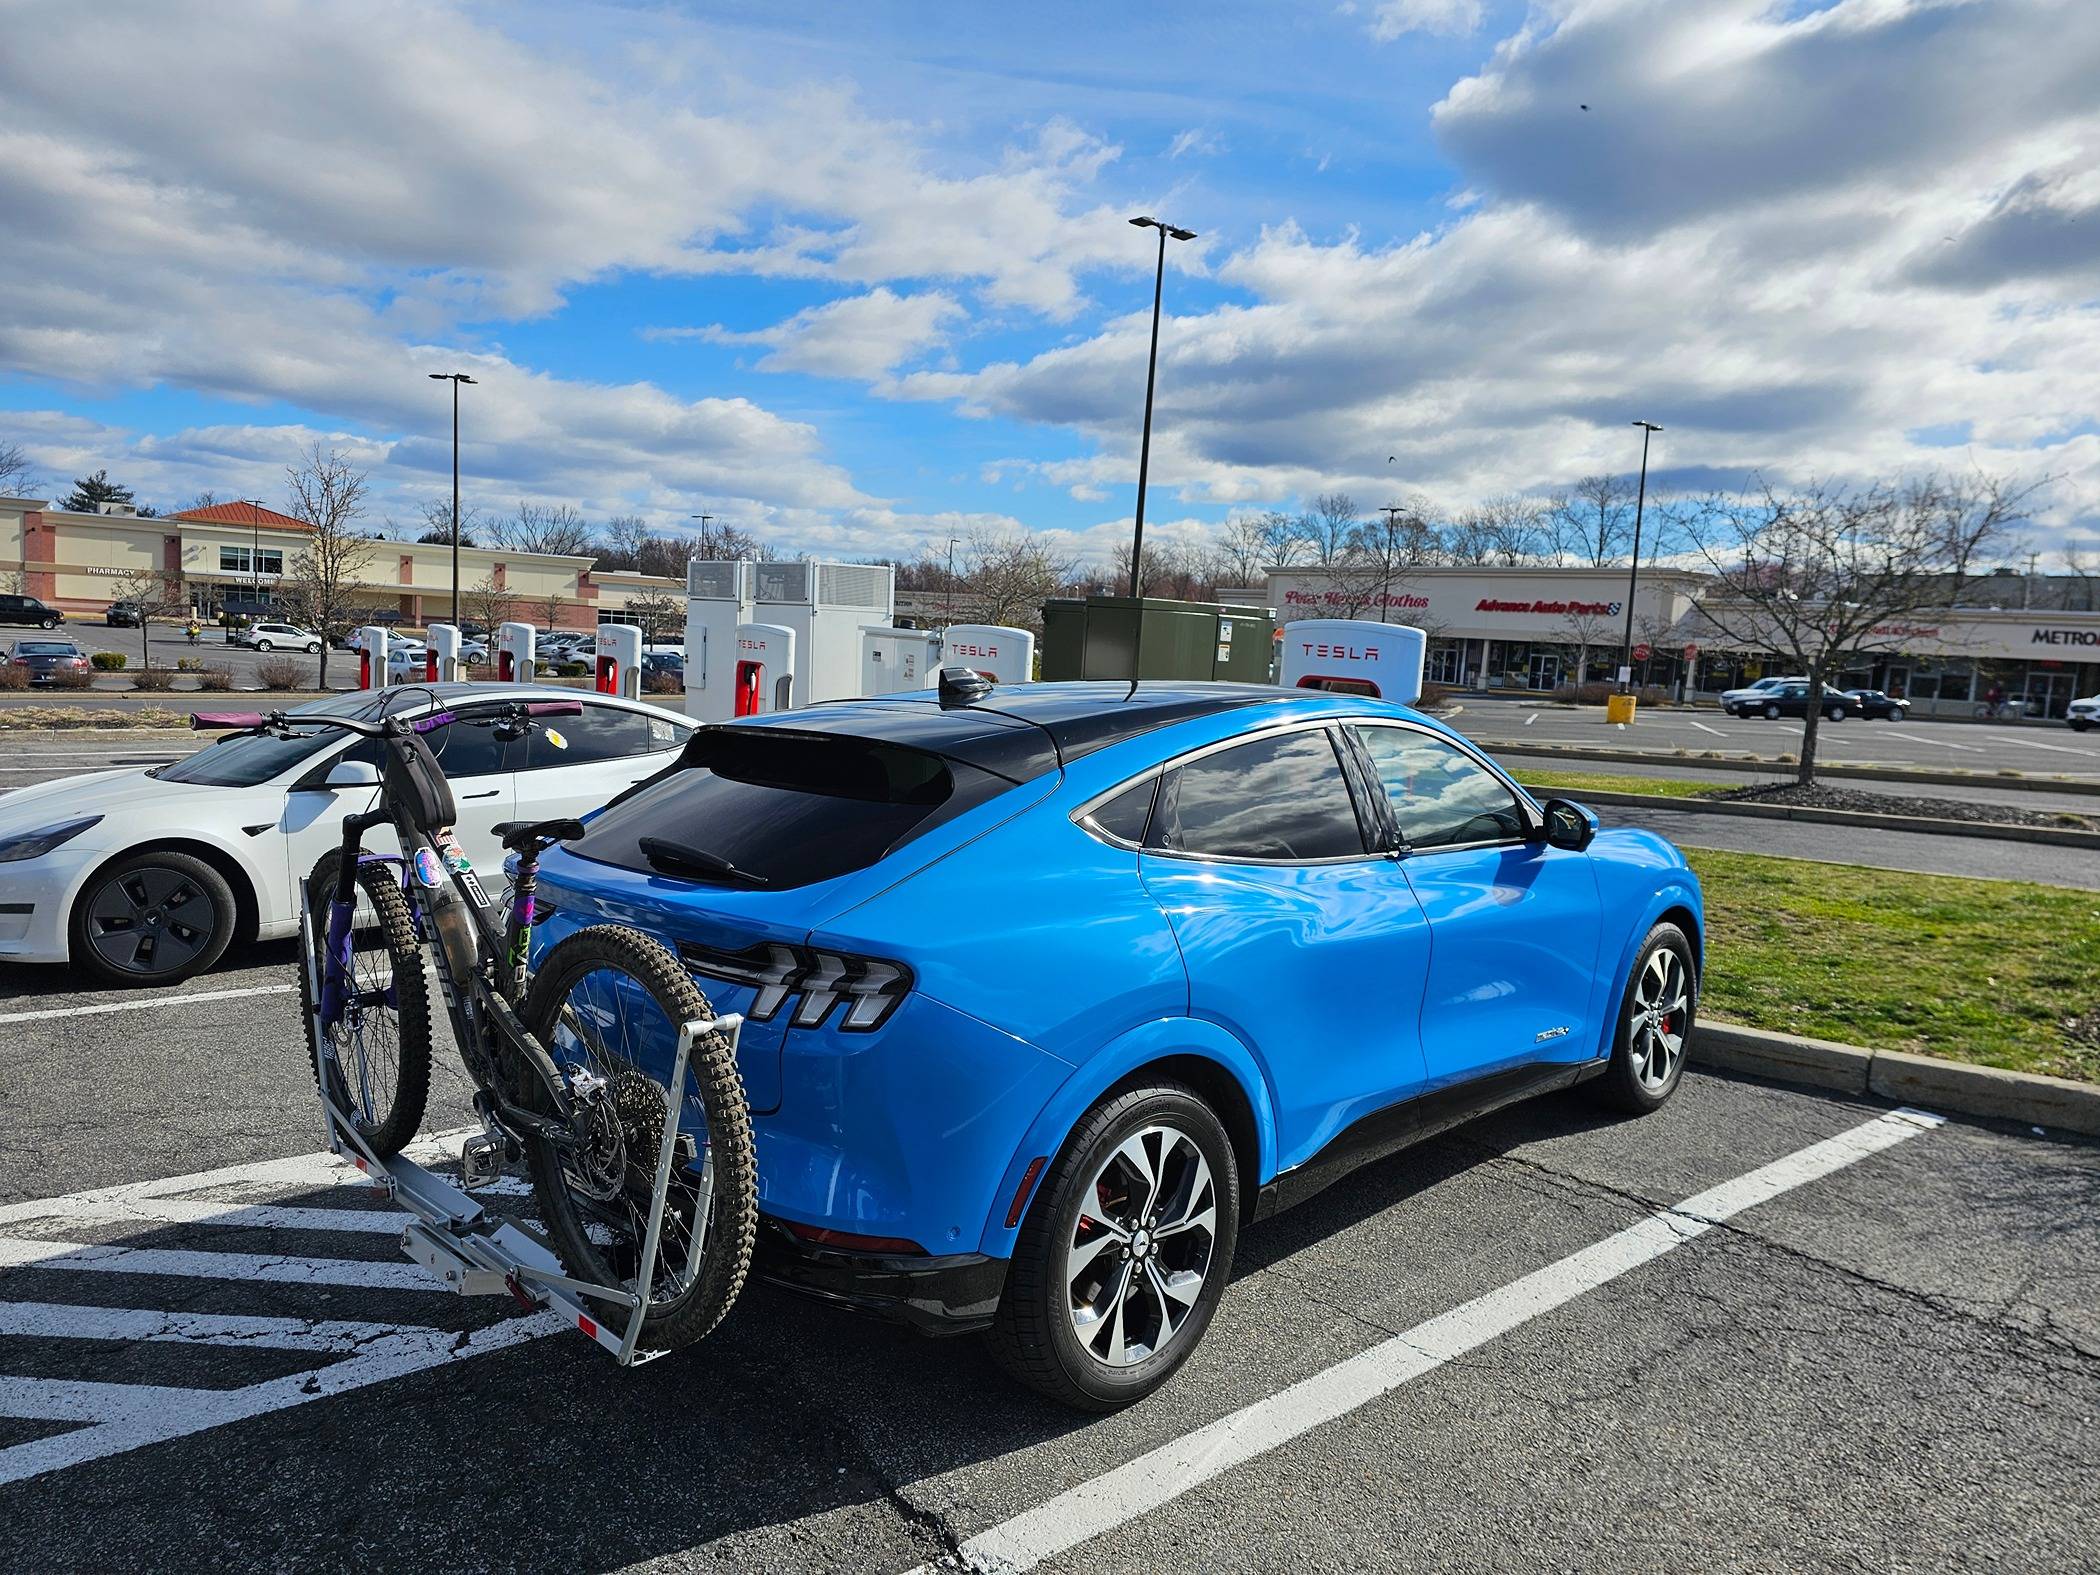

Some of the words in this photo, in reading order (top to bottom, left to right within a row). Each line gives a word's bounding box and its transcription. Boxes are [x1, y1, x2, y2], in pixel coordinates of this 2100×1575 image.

[87, 567, 135, 576] PHARMACY
[1374, 593, 1429, 608] Clothes
[1475, 599, 1530, 613] Advance
[1531, 600, 1566, 614] Auto
[1567, 601, 1608, 615] Parts
[738, 639, 766, 651] TESLA
[2031, 628, 2097, 647] METRO
[952, 644, 998, 658] TESLA
[1302, 643, 1379, 661] TESLA
